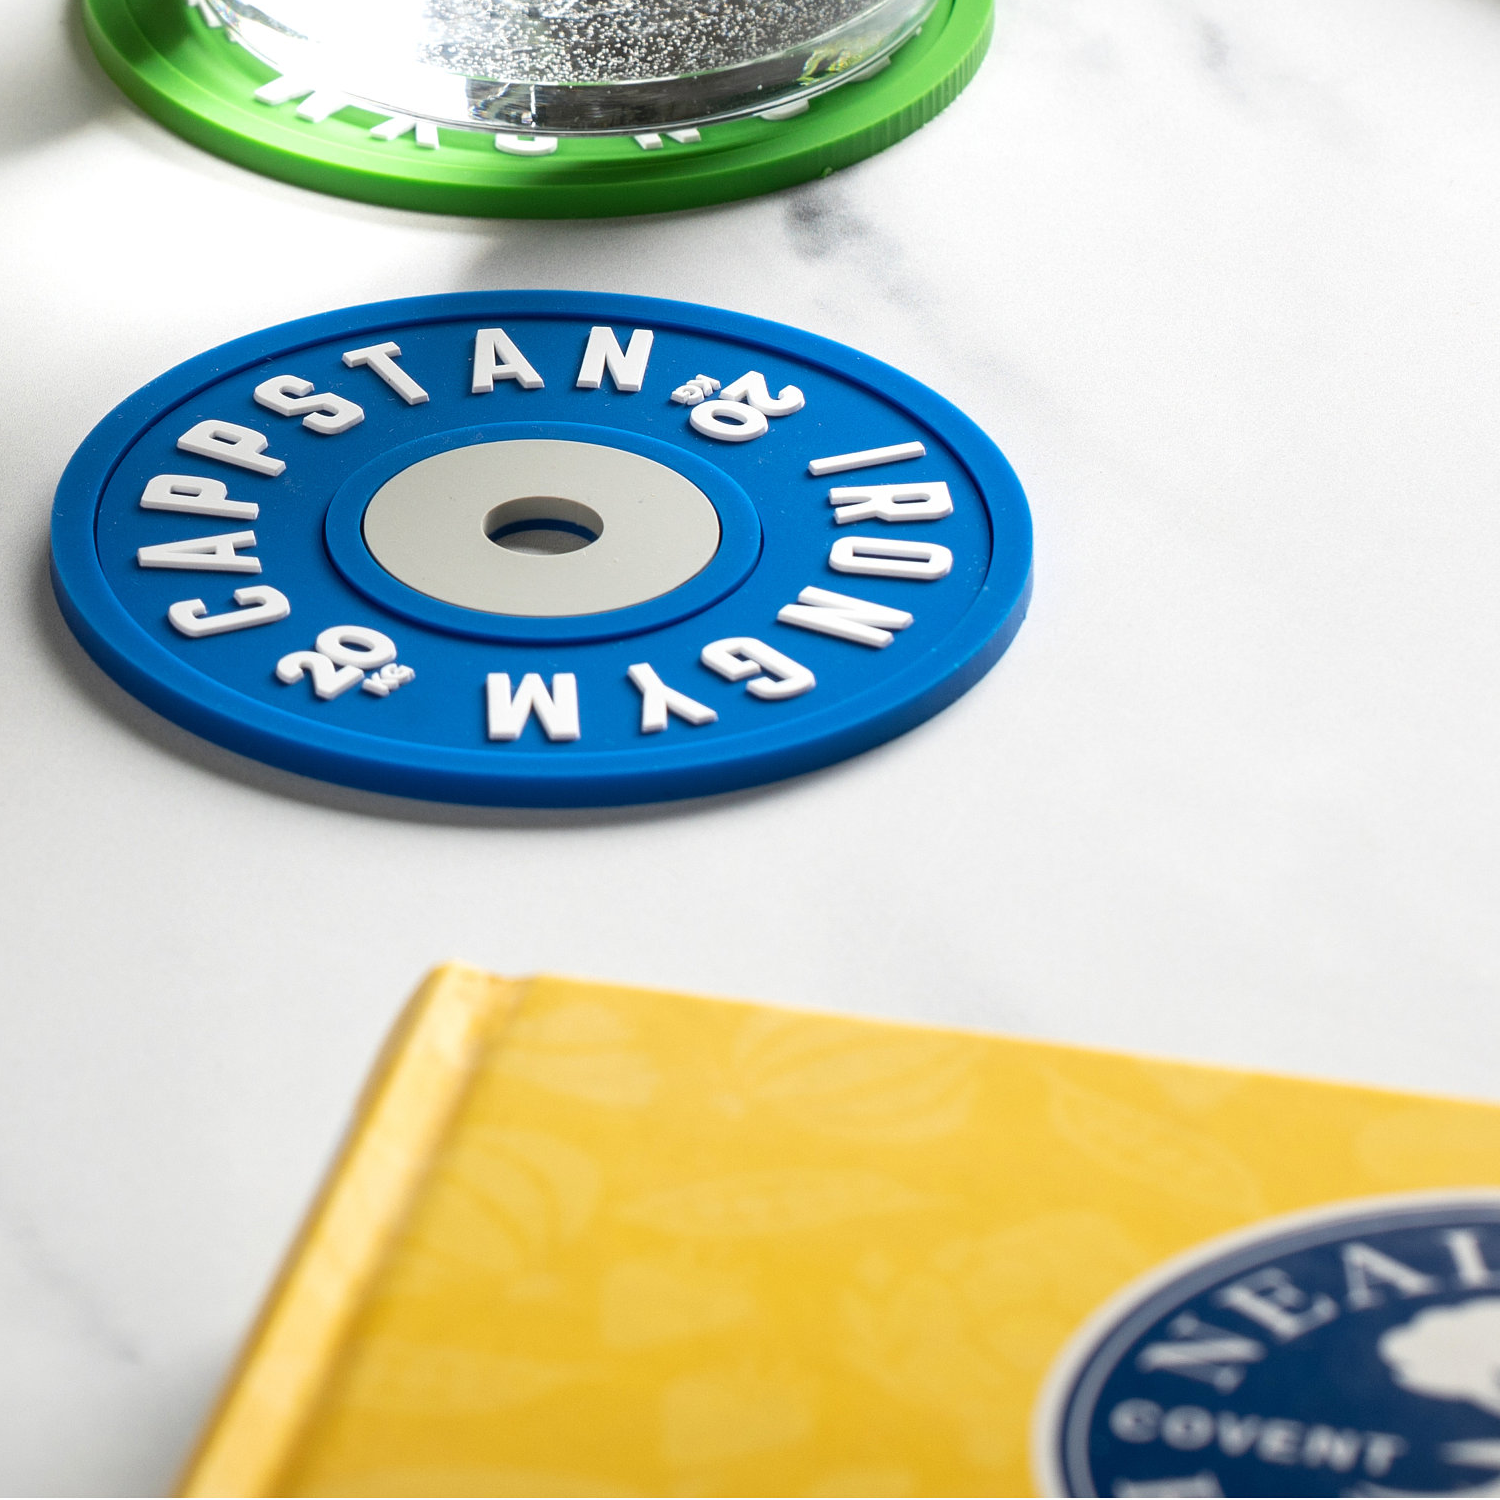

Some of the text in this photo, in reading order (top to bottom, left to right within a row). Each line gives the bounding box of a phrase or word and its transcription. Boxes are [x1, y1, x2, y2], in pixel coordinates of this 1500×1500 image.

[689, 370, 806, 442] 20
[136, 326, 654, 638] CAPPSTAN
[275, 625, 398, 700] 20
[1108, 1397, 1408, 1478] COVENT
